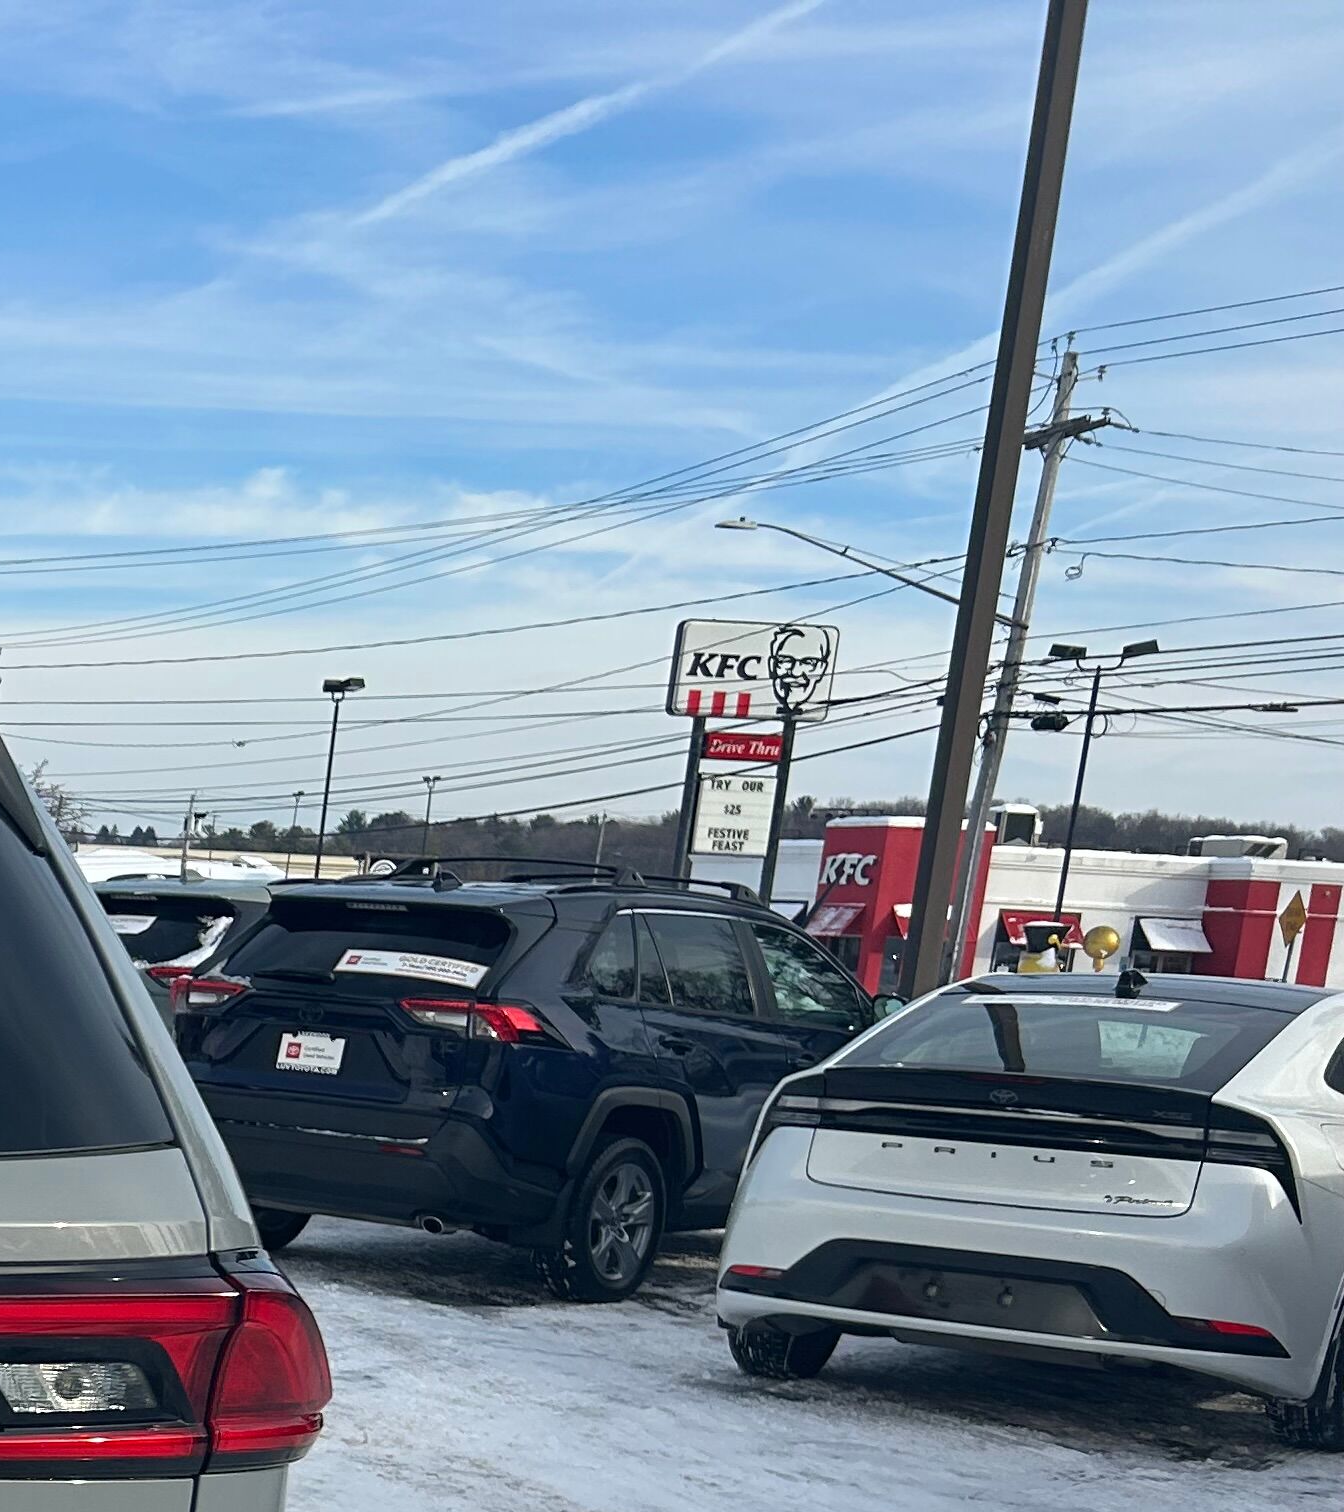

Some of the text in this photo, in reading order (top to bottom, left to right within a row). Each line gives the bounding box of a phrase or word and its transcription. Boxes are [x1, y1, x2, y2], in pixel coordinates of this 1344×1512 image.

[686, 652, 761, 680] KFC
[710, 739, 780, 756] Drive Thru
[711, 779, 764, 792] TRY OUR
[723, 804, 742, 816] $25
[707, 827, 749, 841] FESTIVE
[712, 841, 744, 852] FEAST
[819, 853, 878, 886] KFC
[882, 1141, 1113, 1168] PRIUS
